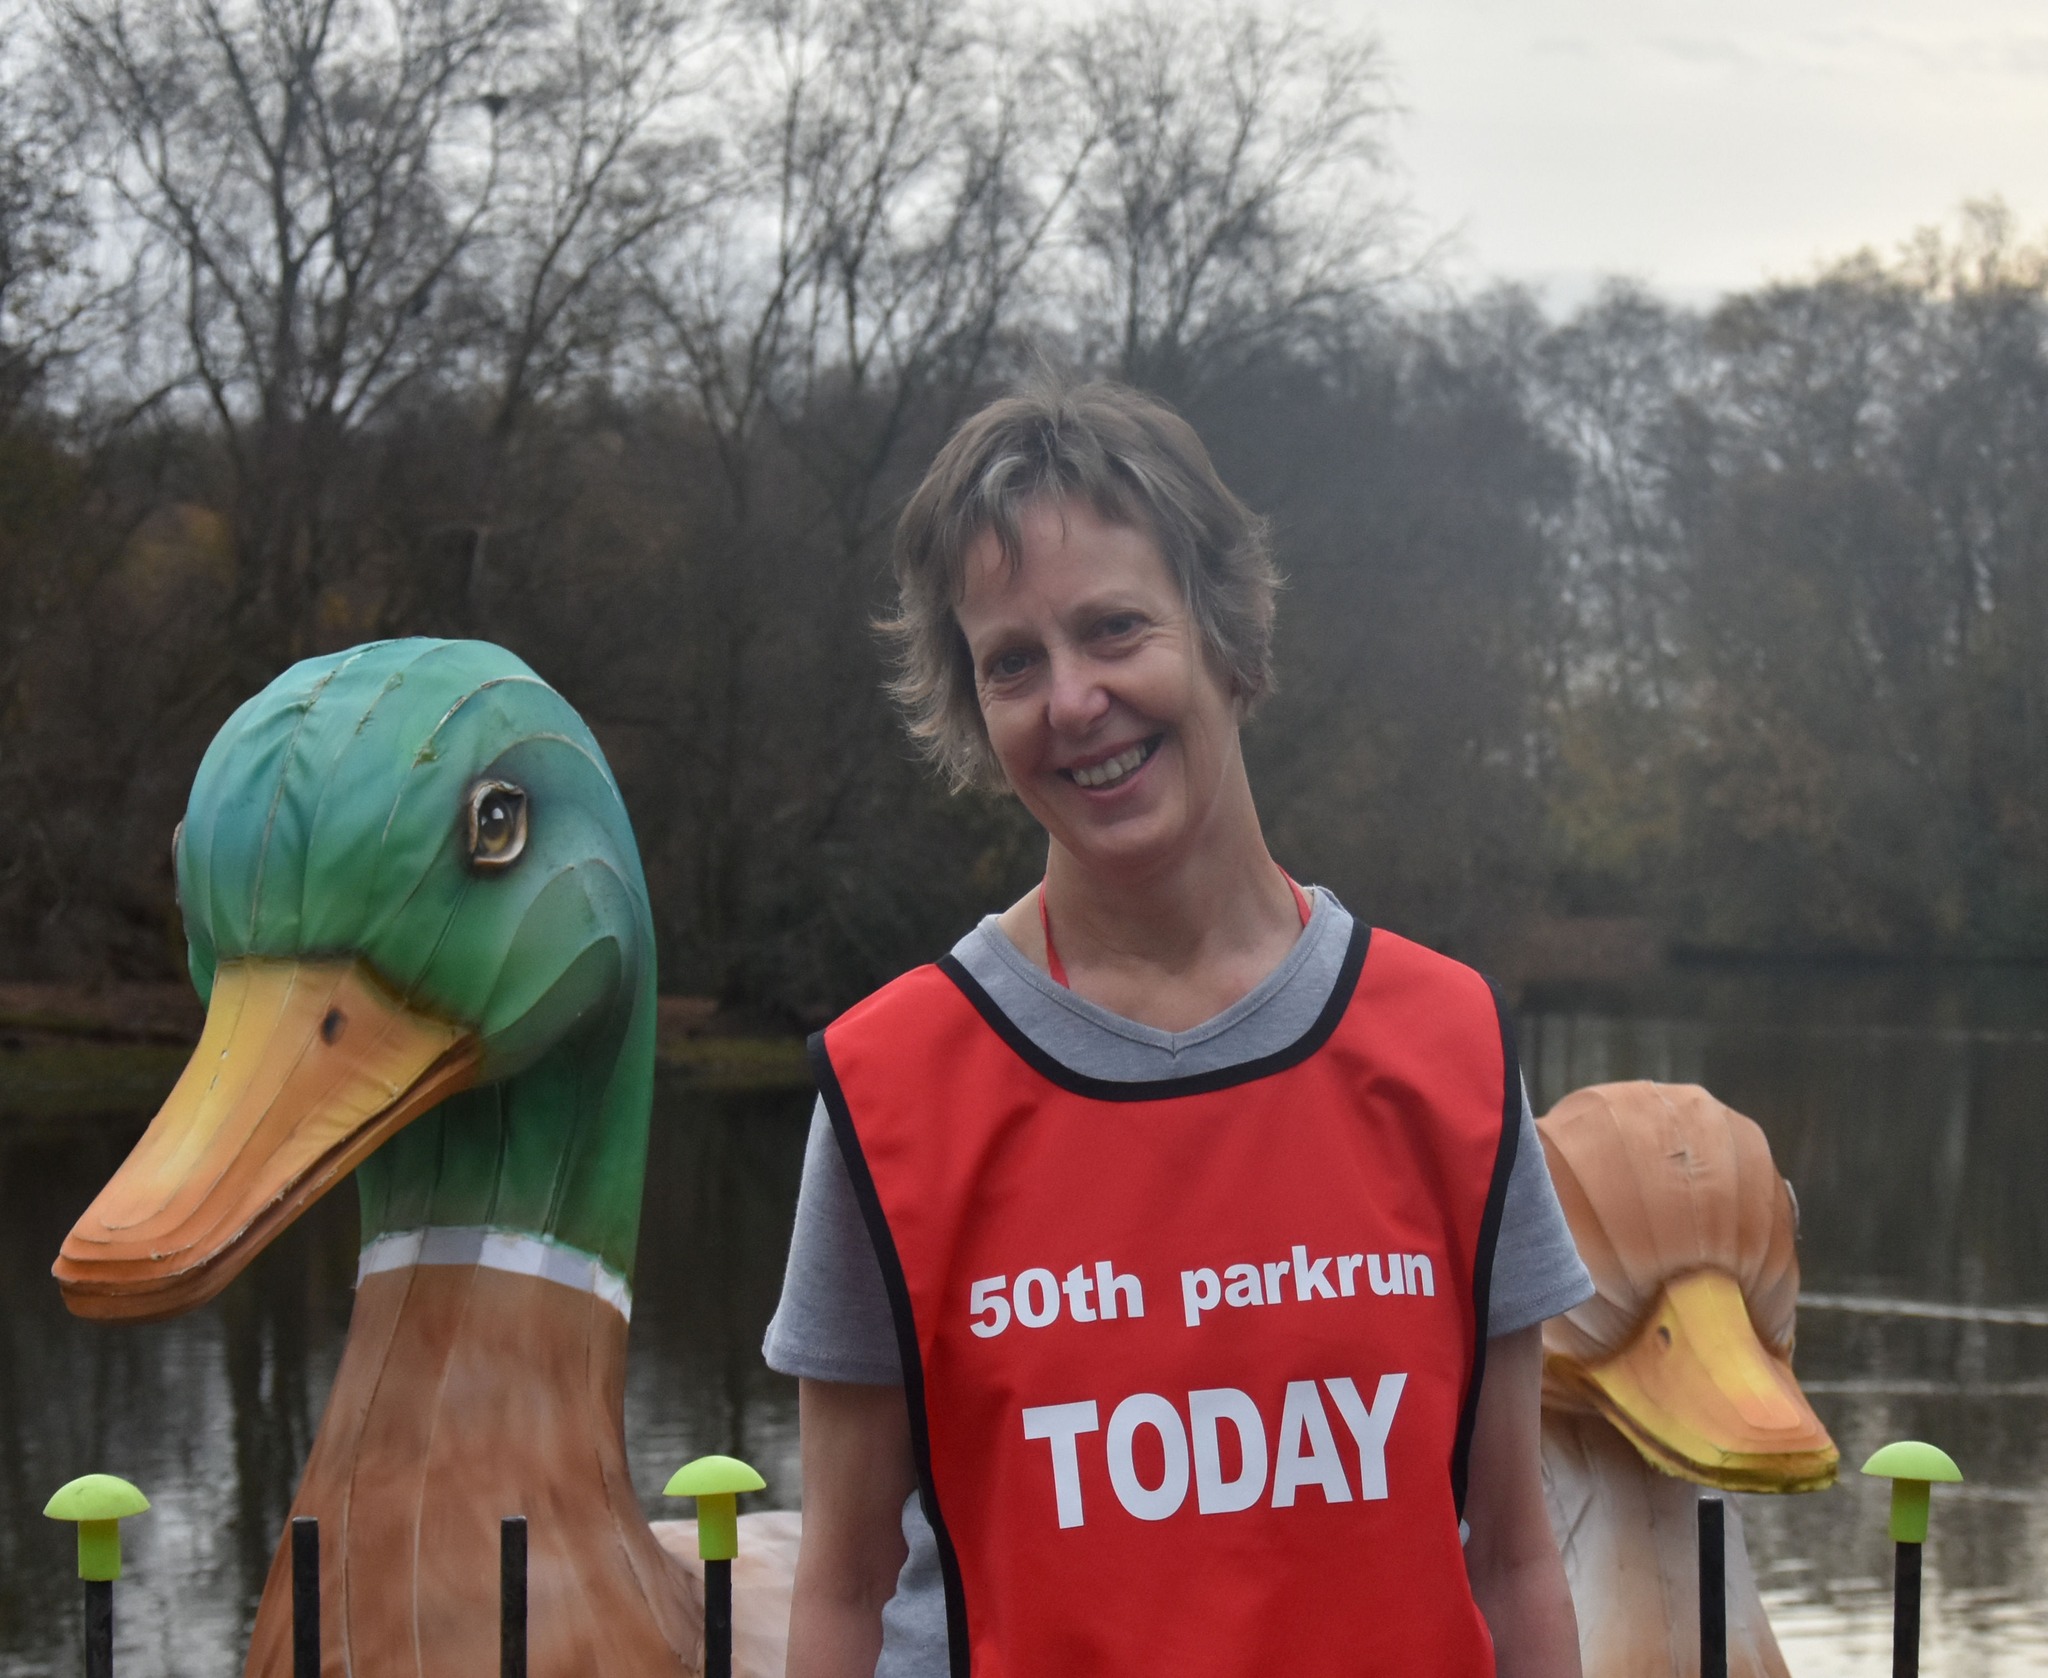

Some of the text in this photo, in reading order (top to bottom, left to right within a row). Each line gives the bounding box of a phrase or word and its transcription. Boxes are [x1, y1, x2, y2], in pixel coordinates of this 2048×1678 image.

[969, 1245, 1435, 1338] 50th parkrun
[1022, 1373, 1408, 1529] TODAY
